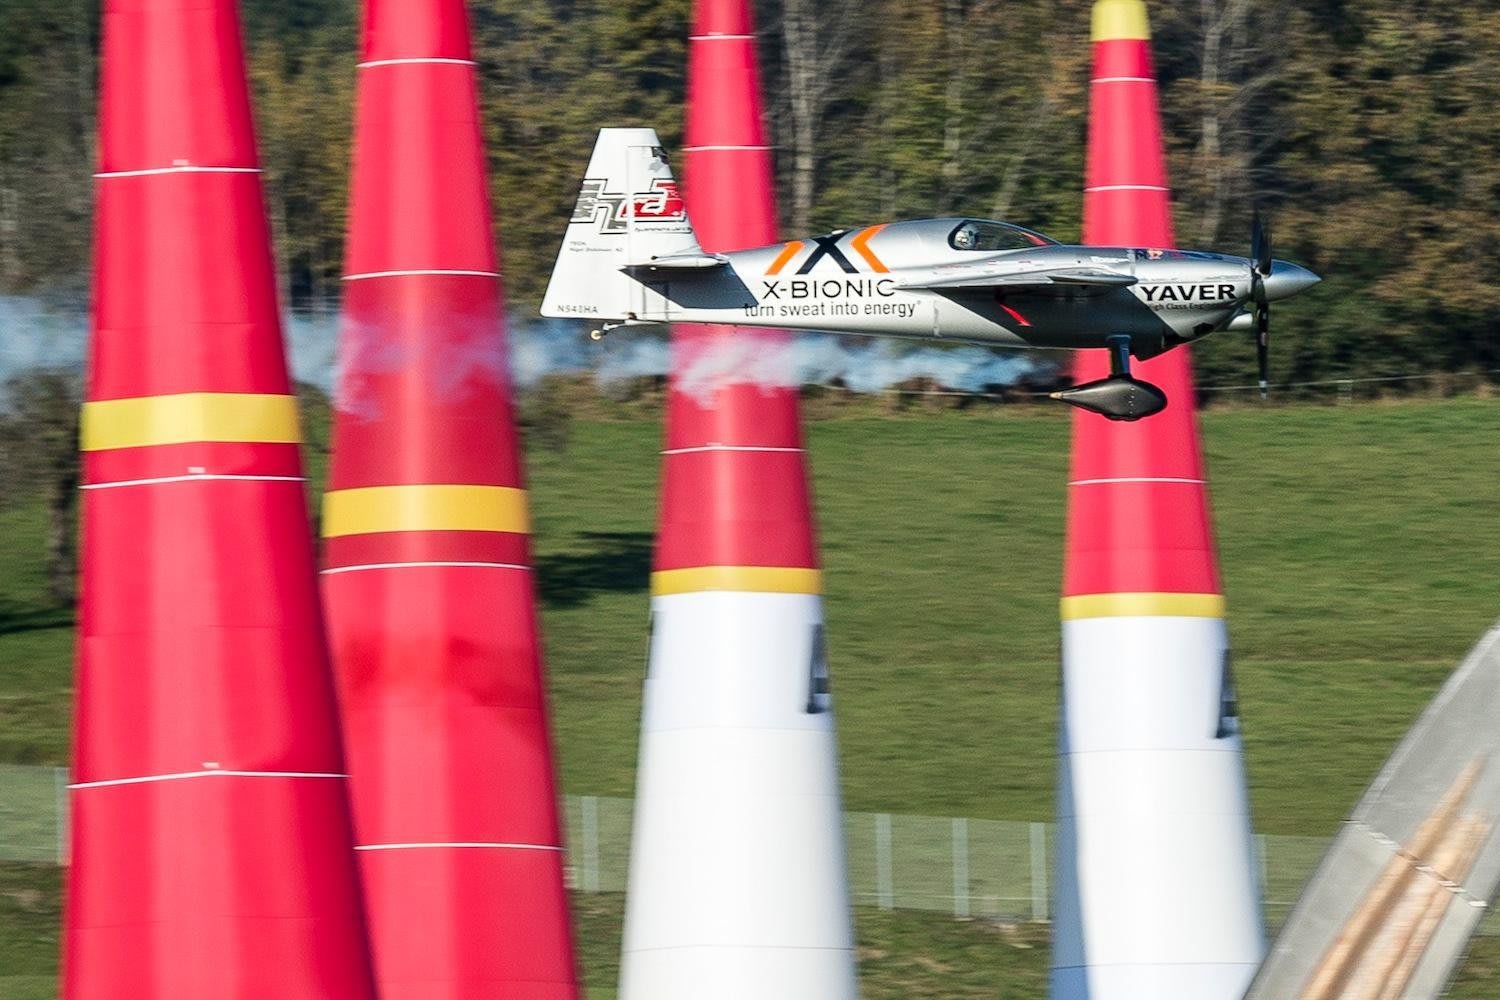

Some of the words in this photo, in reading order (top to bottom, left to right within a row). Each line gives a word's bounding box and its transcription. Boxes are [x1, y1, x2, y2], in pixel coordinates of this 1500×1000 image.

[763, 279, 895, 299] X-BIONIC
[1140, 284, 1236, 301] YAVER
[744, 303, 774, 317] turn
[780, 302, 825, 317] sweat
[831, 302, 859, 316] into
